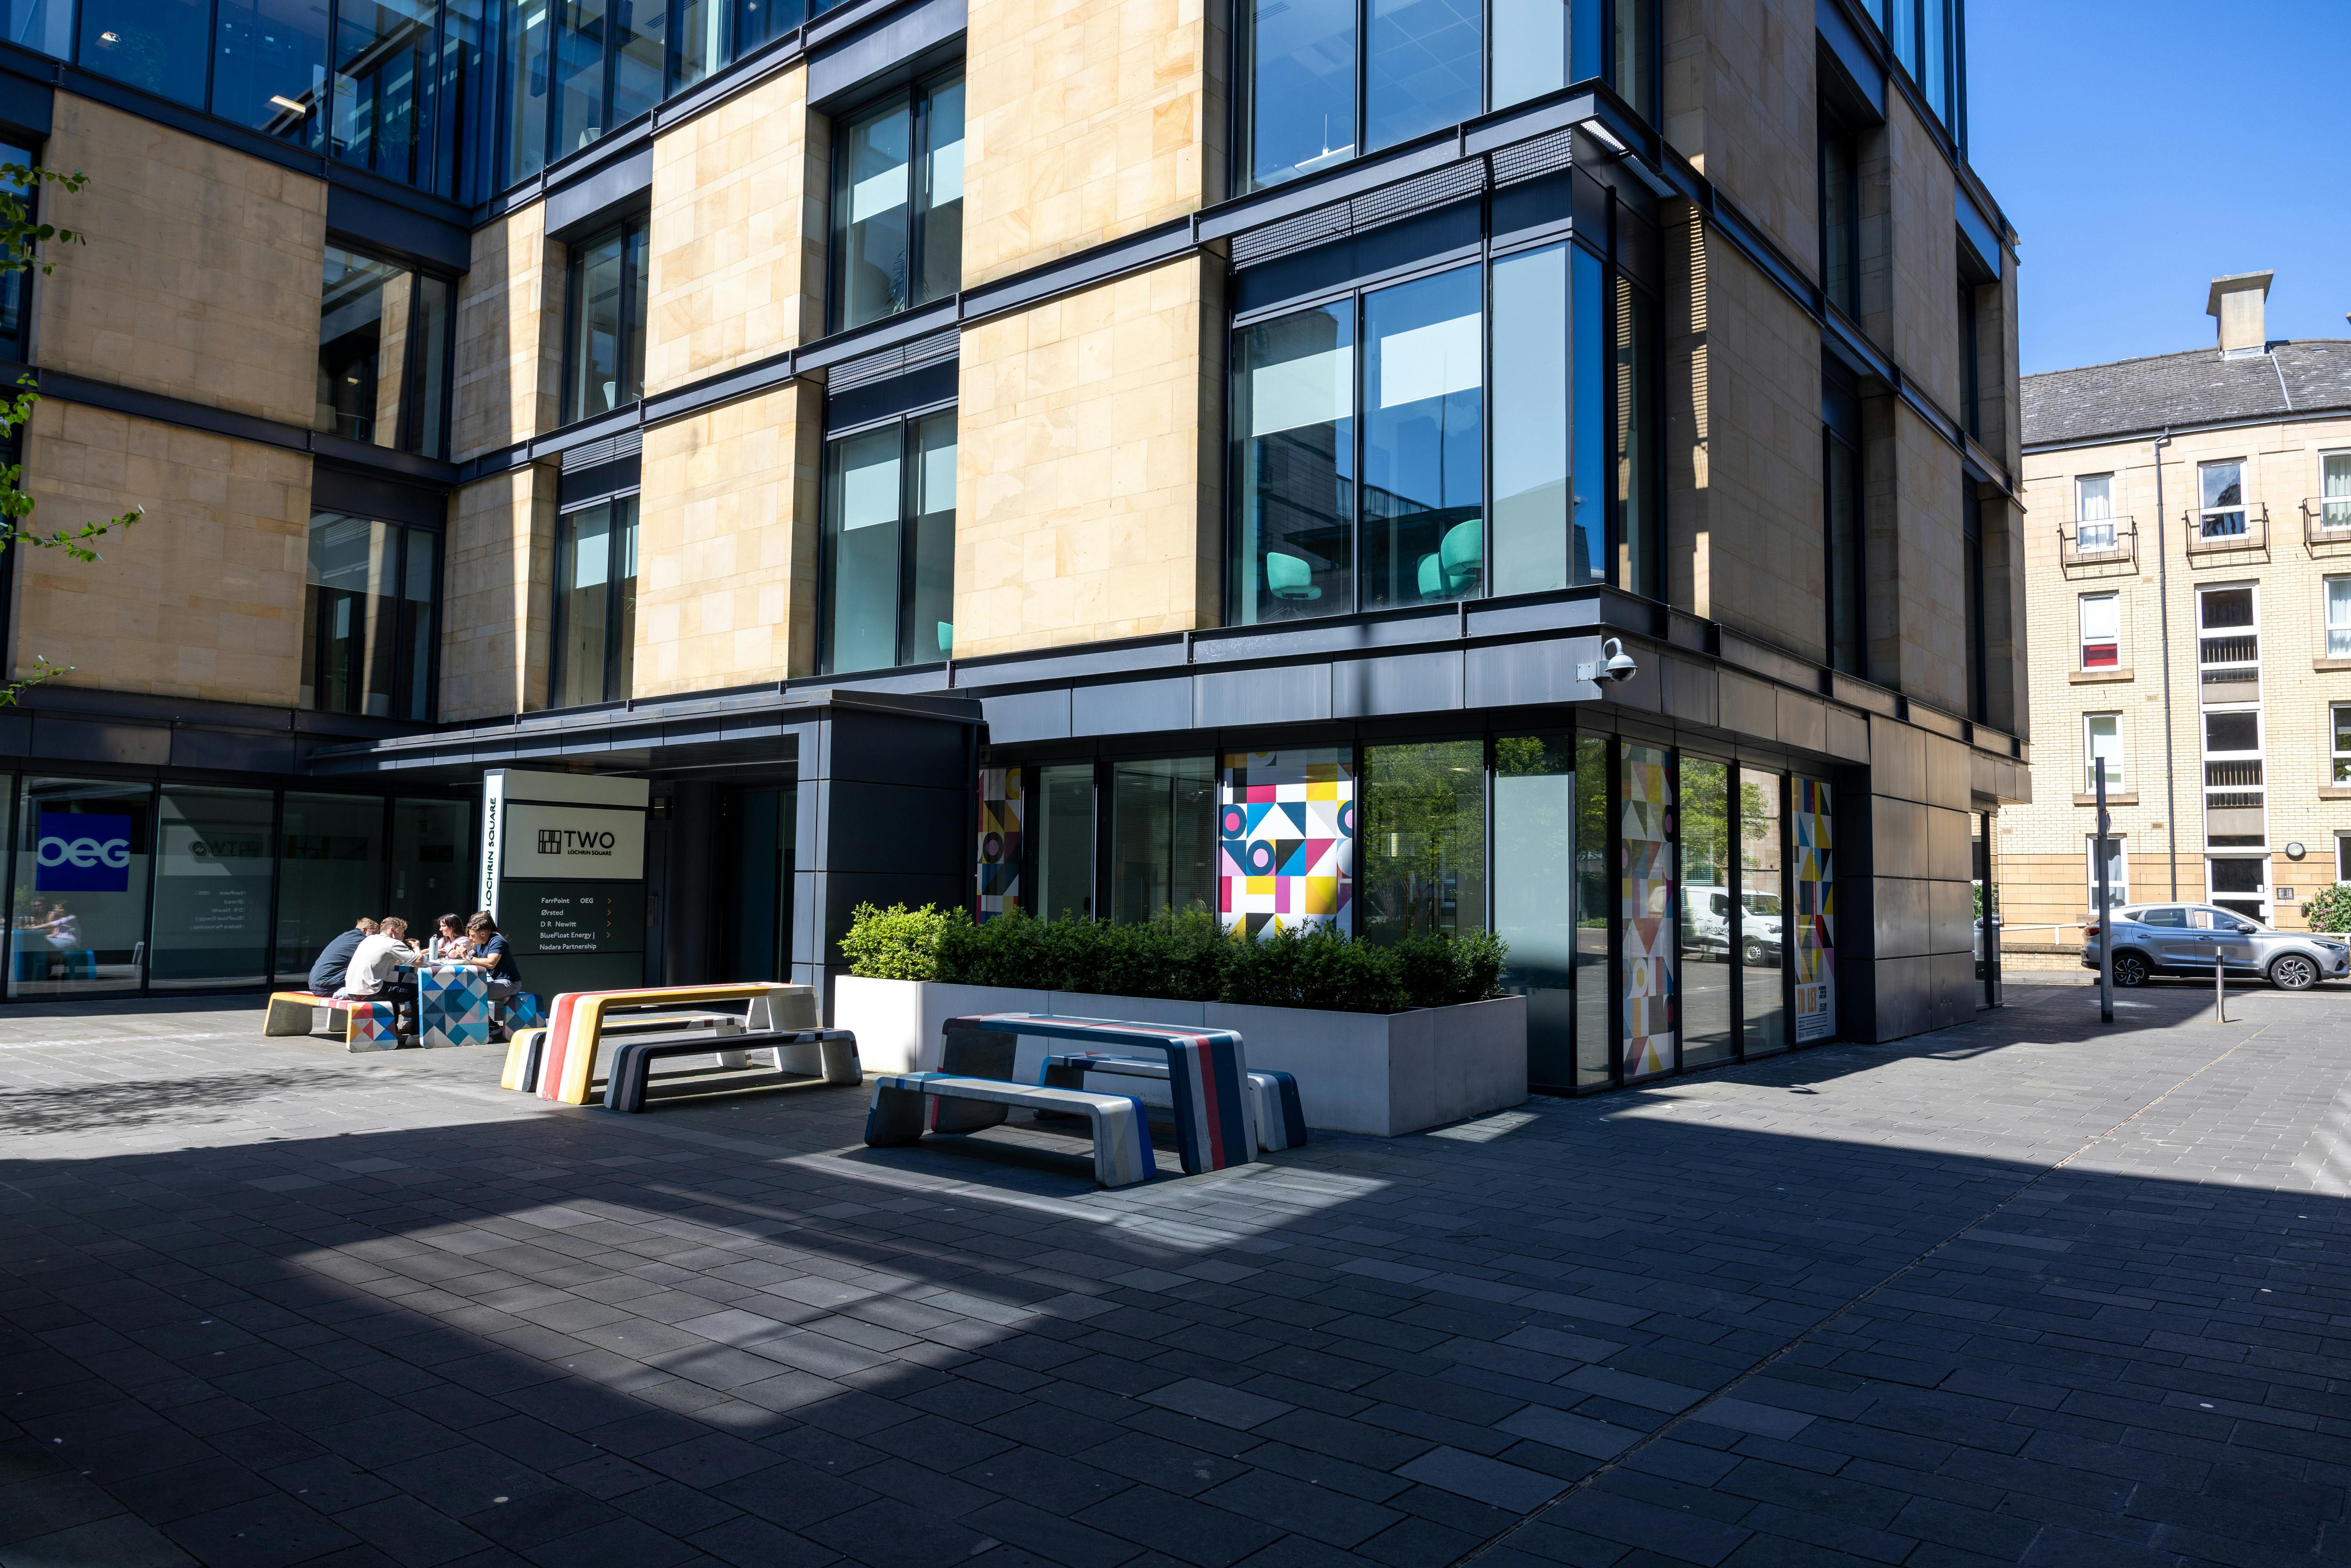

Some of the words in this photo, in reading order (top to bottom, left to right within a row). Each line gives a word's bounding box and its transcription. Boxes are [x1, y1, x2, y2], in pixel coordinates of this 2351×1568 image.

[564, 830, 615, 849] TWO
[1797, 988, 1806, 1014] TO
[1807, 986, 1817, 1013] LET
